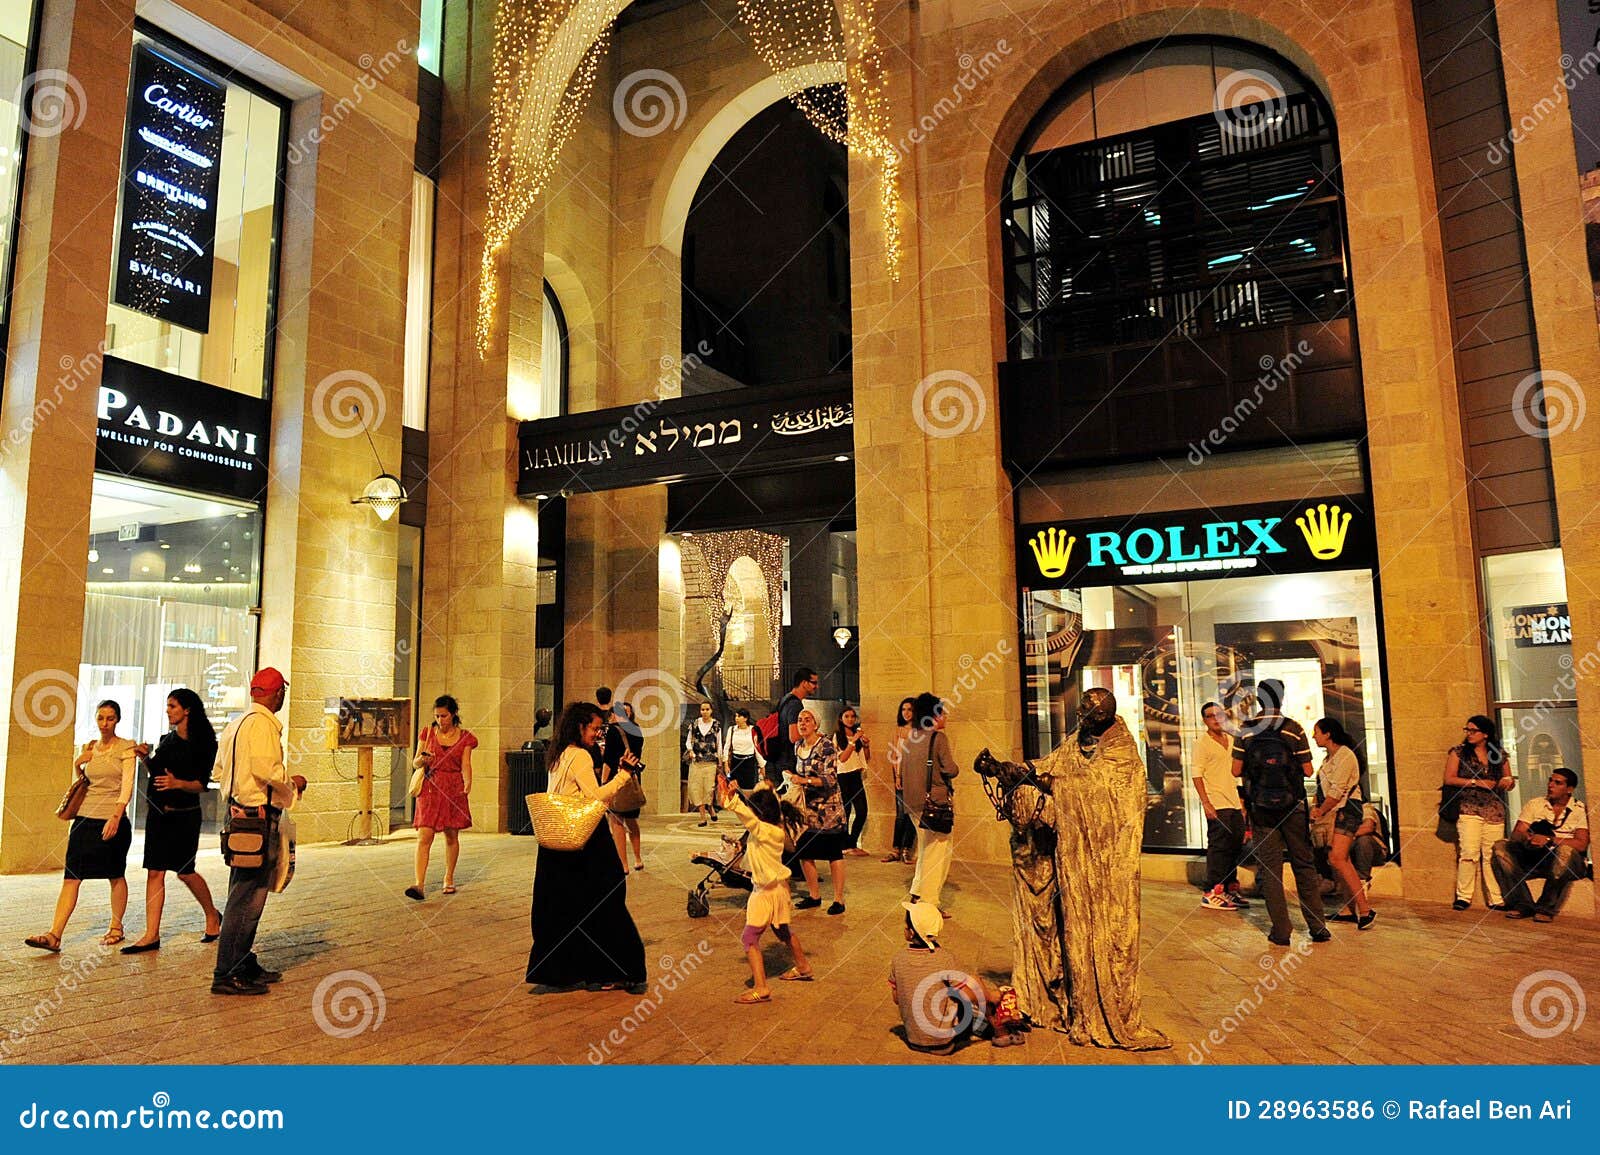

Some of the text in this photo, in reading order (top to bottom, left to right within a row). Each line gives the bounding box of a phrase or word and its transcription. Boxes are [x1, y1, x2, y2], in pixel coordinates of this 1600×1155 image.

[144, 84, 213, 129] Cartier
[136, 171, 207, 210] BREITLING
[129, 260, 202, 295] BVLGARI
[97, 387, 257, 455] PADANI
[635, 418, 741, 456] ממילא
[153, 441, 175, 453] FOR
[178, 447, 253, 471] CONNOISSEURS
[524, 439, 611, 471] MAMILLA
[1086, 517, 1288, 567] ROLEX
